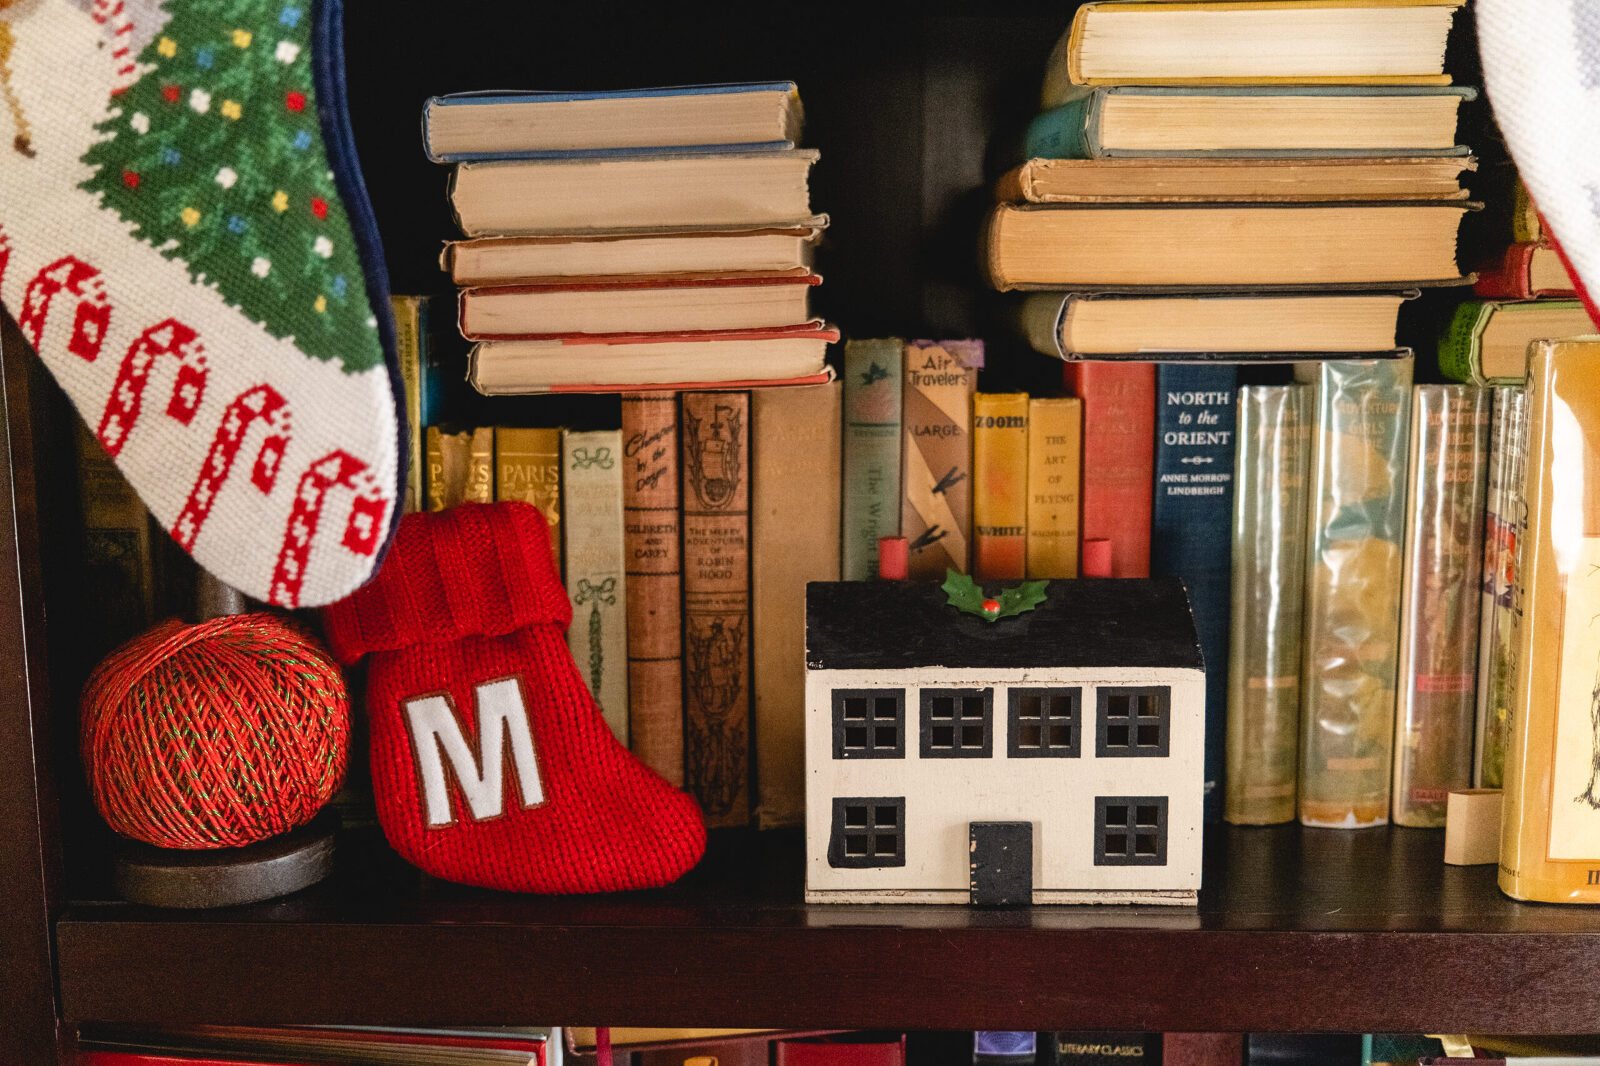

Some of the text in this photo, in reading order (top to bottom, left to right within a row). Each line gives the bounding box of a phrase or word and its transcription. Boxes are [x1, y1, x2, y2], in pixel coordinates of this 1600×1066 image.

[920, 355, 952, 371] Air
[908, 370, 968, 386] Travelers
[1167, 391, 1230, 405] NORTH
[1178, 410, 1219, 425] to the
[914, 425, 960, 437] LARGE
[1045, 436, 1067, 445] THE
[1164, 431, 1231, 446] ORIENT
[1044, 455, 1067, 465] ART
[432, 463, 490, 482] PIS
[503, 464, 559, 483] PARIS
[868, 465, 883, 495] The
[1048, 475, 1062, 484] OF
[1160, 474, 1230, 483] ANNE MORROW
[1167, 486, 1224, 496] LINDBERGH
[1034, 494, 1074, 505] FLYING
[625, 524, 677, 535] GILBRETH
[689, 527, 707, 536] THE
[977, 526, 1024, 537] WHITE
[644, 538, 662, 546] AND
[634, 548, 668, 559] CAREY
[698, 556, 735, 567] ROBIN
[699, 569, 733, 580] HOOD
[403, 677, 546, 826] M
[1059, 1043, 1144, 1056] LITERARY CLASSICS
